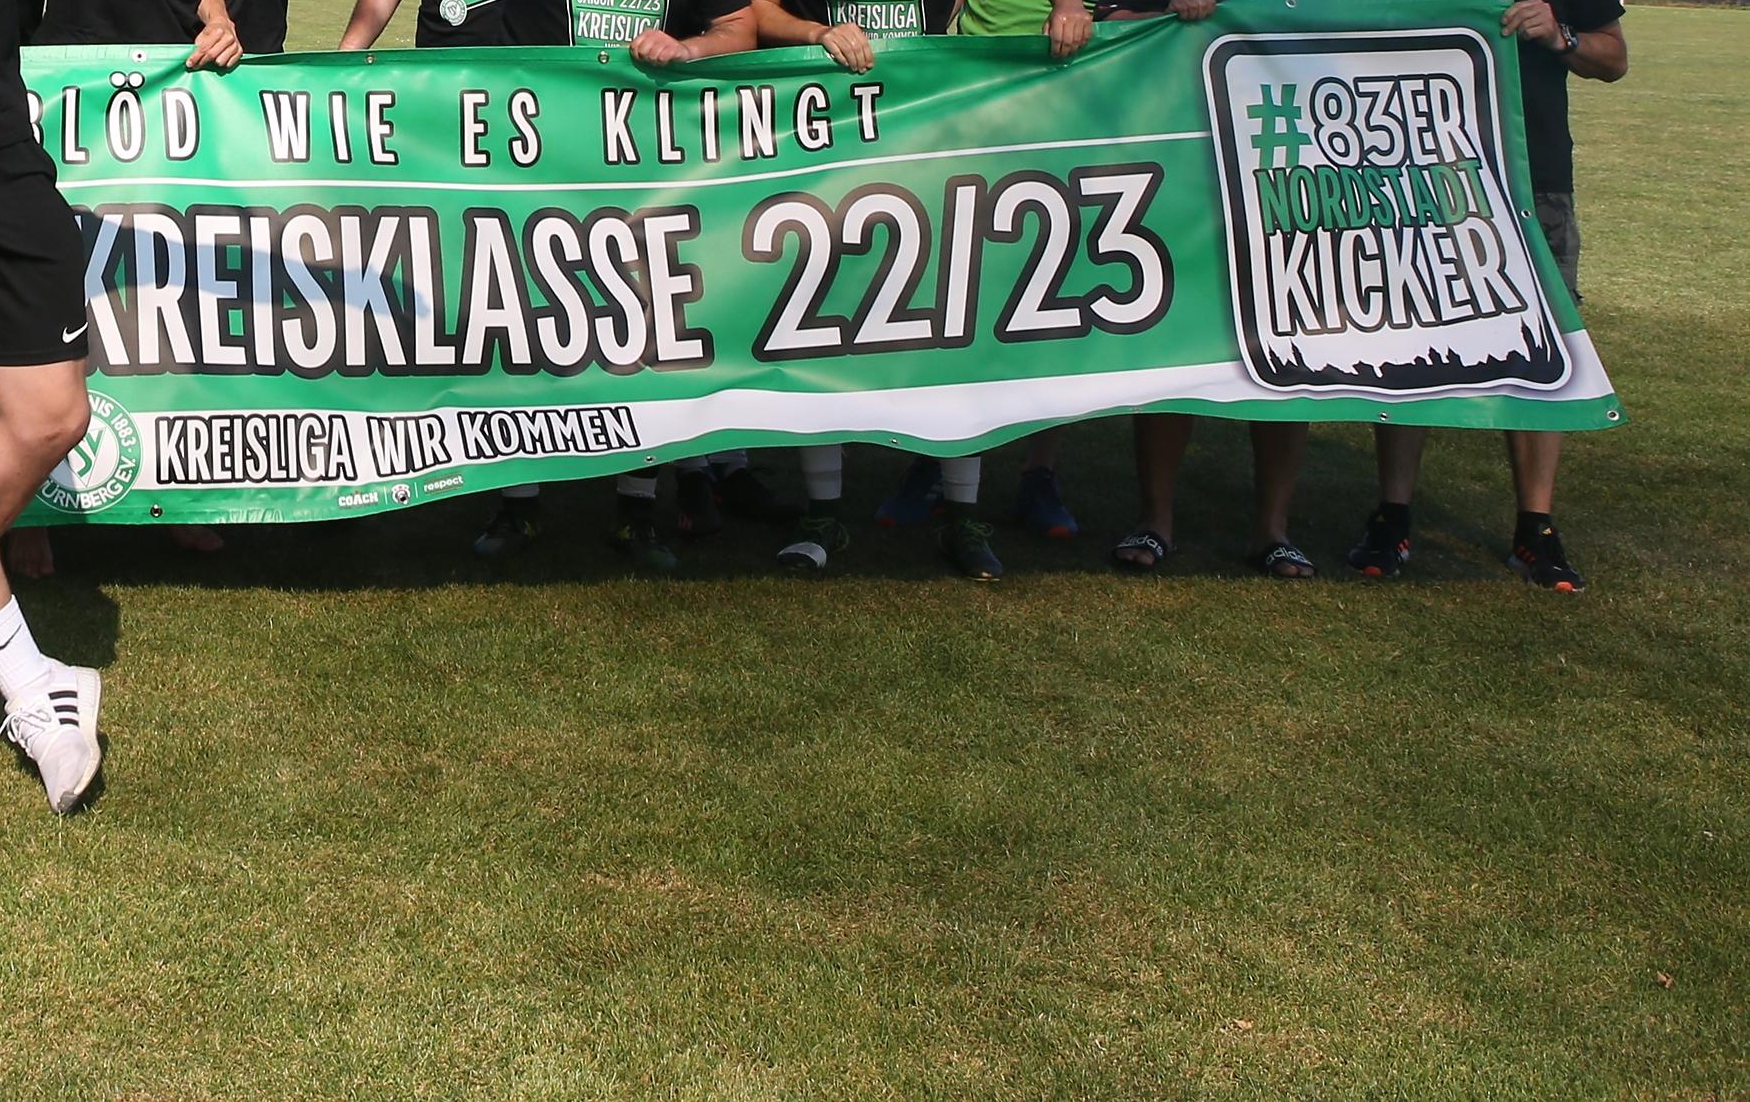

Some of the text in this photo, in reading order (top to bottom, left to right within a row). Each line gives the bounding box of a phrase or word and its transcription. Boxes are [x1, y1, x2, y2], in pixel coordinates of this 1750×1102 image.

[837, 2, 917, 29] KREISLIGA
[260, 89, 399, 166] WIE
[460, 88, 541, 168] ES
[601, 83, 884, 165] KLINGT
[1246, 73, 1481, 169] #83ER
[1253, 159, 1494, 234] NORDSTADT
[78, 208, 710, 374] KREISKLASSE
[747, 166, 1169, 357] 22/23
[1268, 214, 1529, 336] KICKER
[110, 413, 136, 447] 1883
[154, 406, 641, 488] KREISLIGA WIR KOMMEN
[41, 479, 123, 509] ÜRNBERG
[338, 490, 379, 507] COACH
